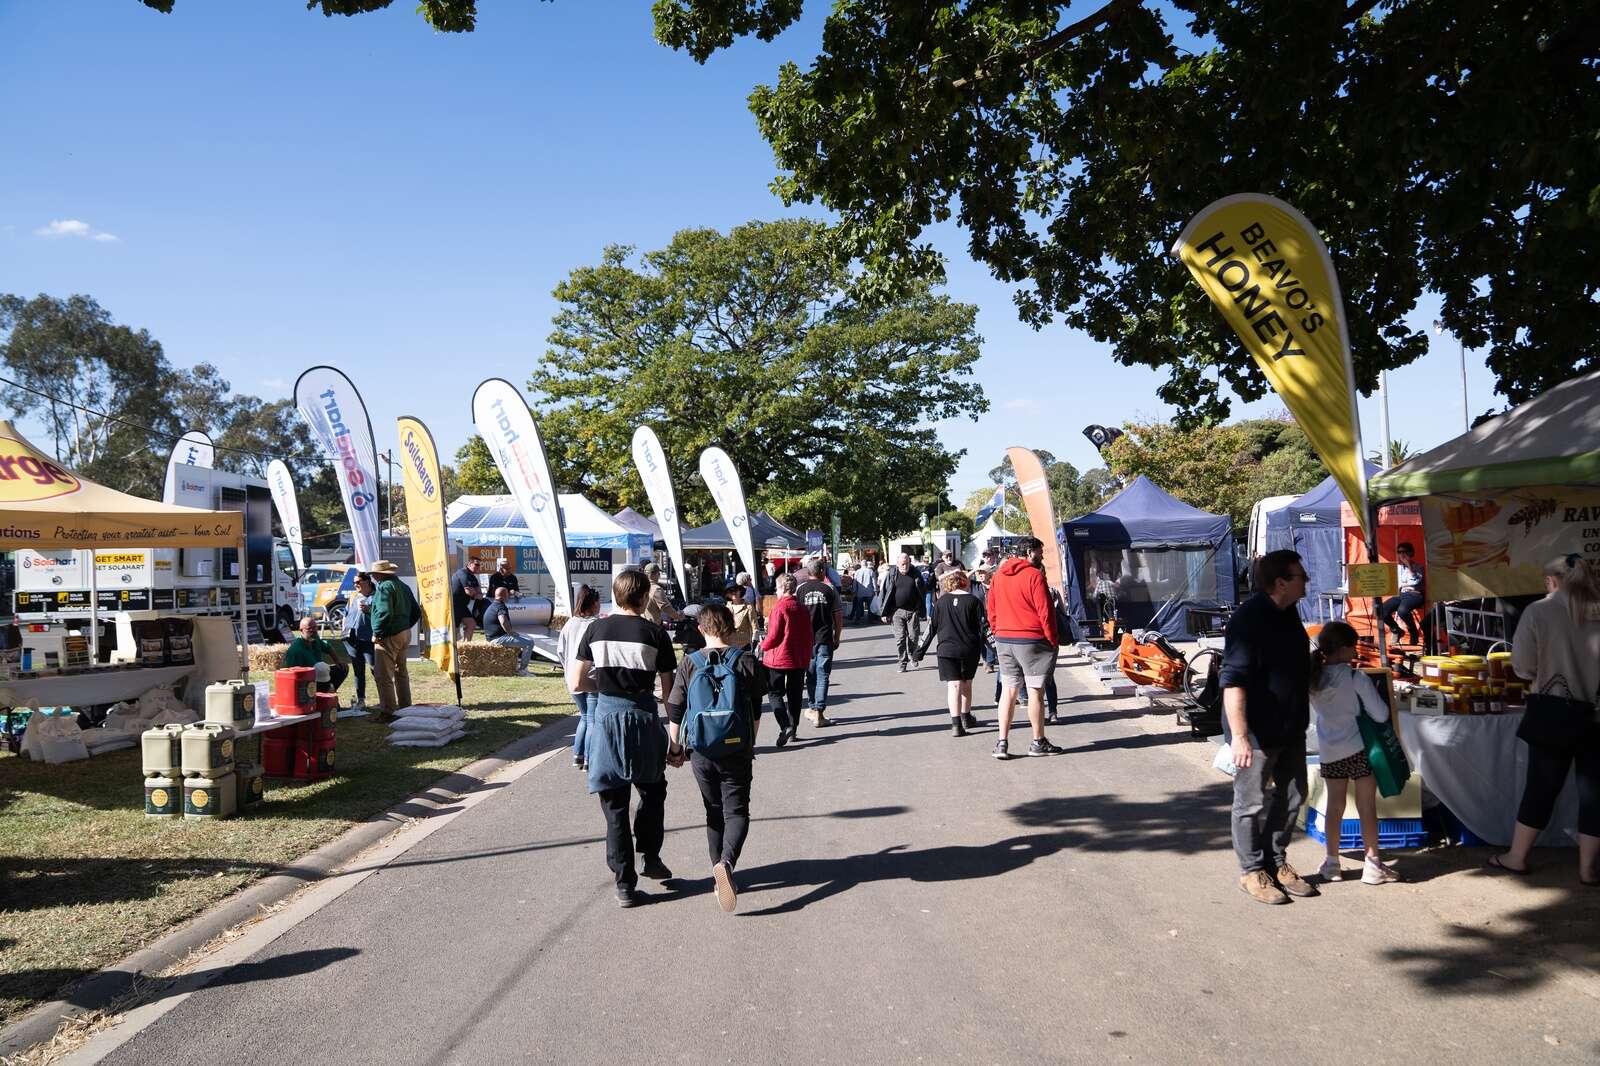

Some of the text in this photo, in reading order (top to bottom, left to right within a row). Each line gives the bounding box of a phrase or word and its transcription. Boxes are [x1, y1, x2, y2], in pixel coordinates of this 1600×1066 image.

[1240, 222, 1324, 334] BEAVO'S
[1196, 231, 1306, 362] HONEY
[404, 431, 435, 498] Soilcharge
[0, 525, 40, 539] tions
[54, 526, 97, 541] Protecting
[102, 530, 121, 541] your
[124, 528, 156, 540] greatest
[158, 528, 178, 538] asset
[192, 525, 211, 536] Your
[213, 525, 232, 536] Soil
[480, 549, 502, 559] SOLA
[575, 548, 600, 559] SOLAR
[33, 557, 76, 567] Solahart
[523, 561, 547, 570] STORA
[582, 560, 609, 571] WATER
